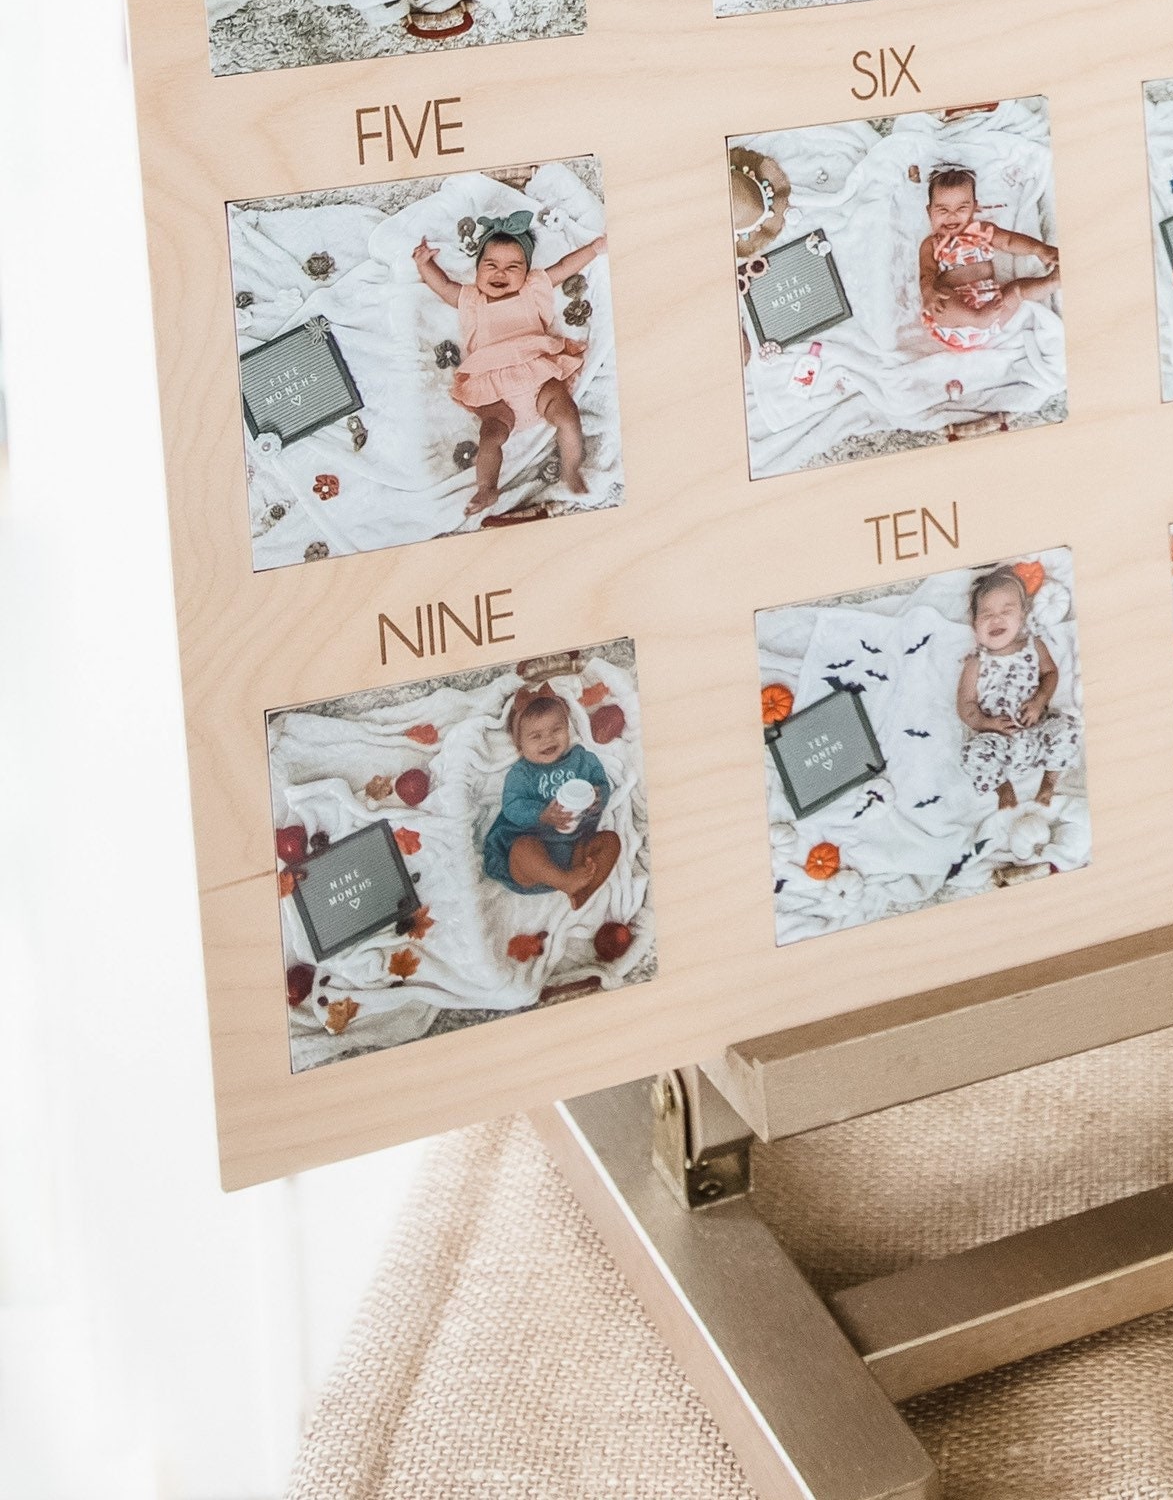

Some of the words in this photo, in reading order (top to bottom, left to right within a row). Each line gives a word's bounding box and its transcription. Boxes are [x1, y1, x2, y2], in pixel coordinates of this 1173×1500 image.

[851, 46, 921, 100] SIX
[356, 98, 464, 165] FIVE
[771, 284, 812, 308] MONTHS
[777, 276, 798, 291] SIX
[265, 373, 318, 405] MONTHS
[269, 366, 299, 387] FIVE
[864, 501, 959, 562] TEN
[378, 588, 515, 666] NINE
[804, 741, 843, 768] MONTHS
[807, 734, 829, 749] TEN
[329, 878, 372, 906] MONTHS
[330, 869, 359, 890] NINE
